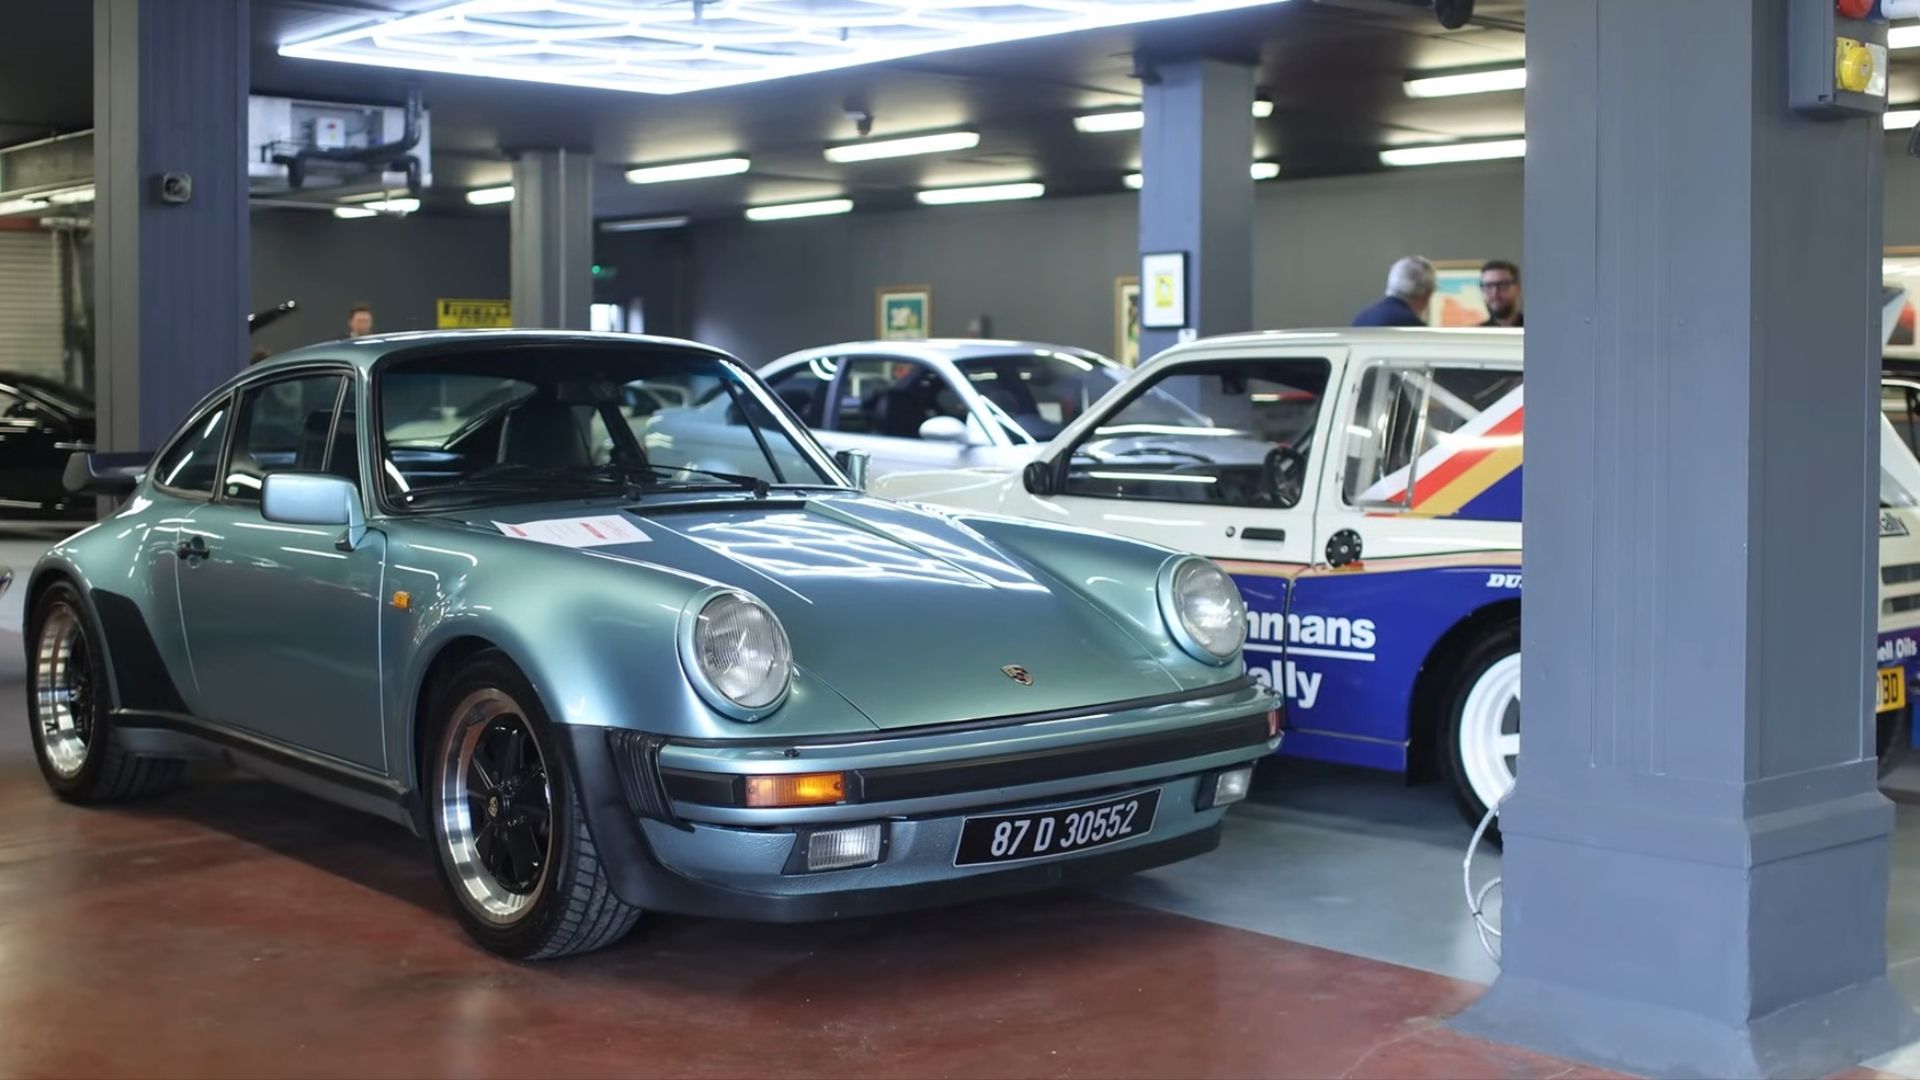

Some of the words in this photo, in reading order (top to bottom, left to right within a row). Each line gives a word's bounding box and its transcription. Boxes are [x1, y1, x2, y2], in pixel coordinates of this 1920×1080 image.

[1486, 573, 1522, 588] DU
[1896, 637, 1917, 658] Oils
[1243, 660, 1322, 709] ally
[990, 820, 1031, 857] 87
[1033, 817, 1056, 852] D
[1060, 800, 1139, 848] 30552
